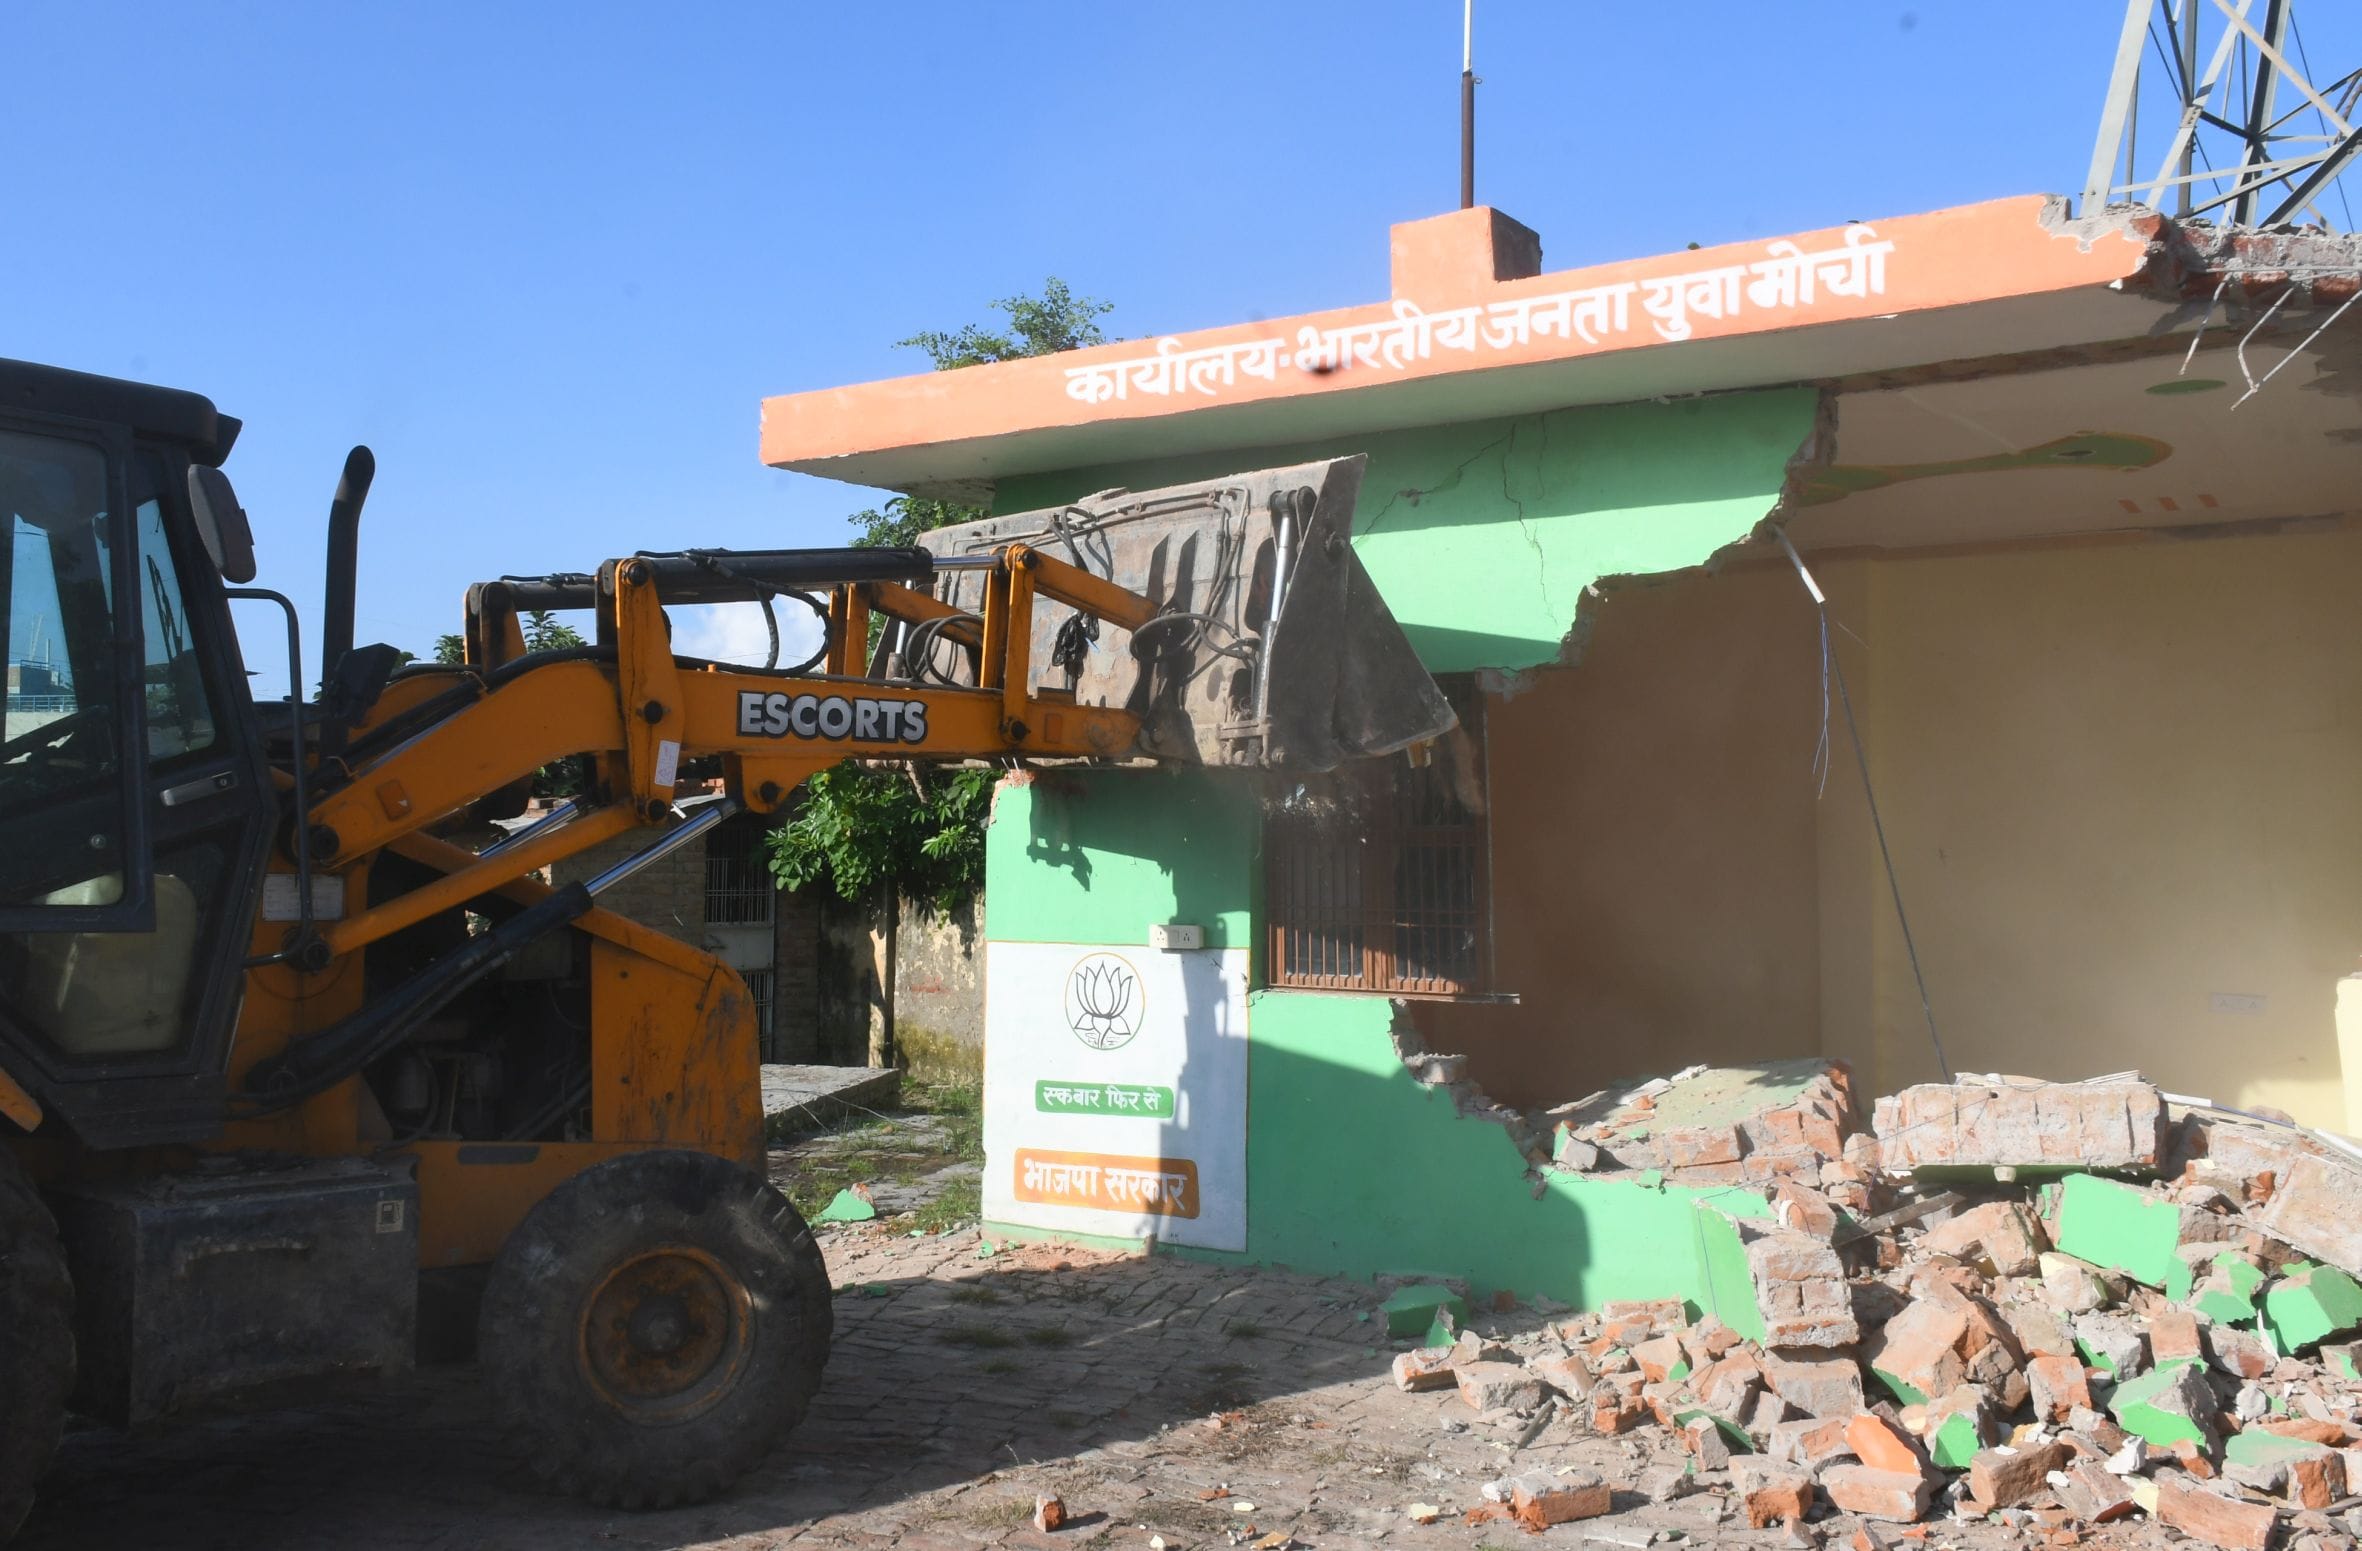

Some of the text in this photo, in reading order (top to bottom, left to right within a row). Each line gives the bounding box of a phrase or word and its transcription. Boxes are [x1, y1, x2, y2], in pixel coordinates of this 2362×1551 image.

[1481, 282, 1637, 349] जनता
[1642, 264, 1750, 342] युवा
[1748, 225, 1895, 309] मोर्चा
[738, 691, 928, 744] ESCORTS
[1104, 1084, 1141, 1112] फिर
[1142, 1085, 1162, 1111] से
[1023, 1157, 1188, 1211] भाजपा सरकार
